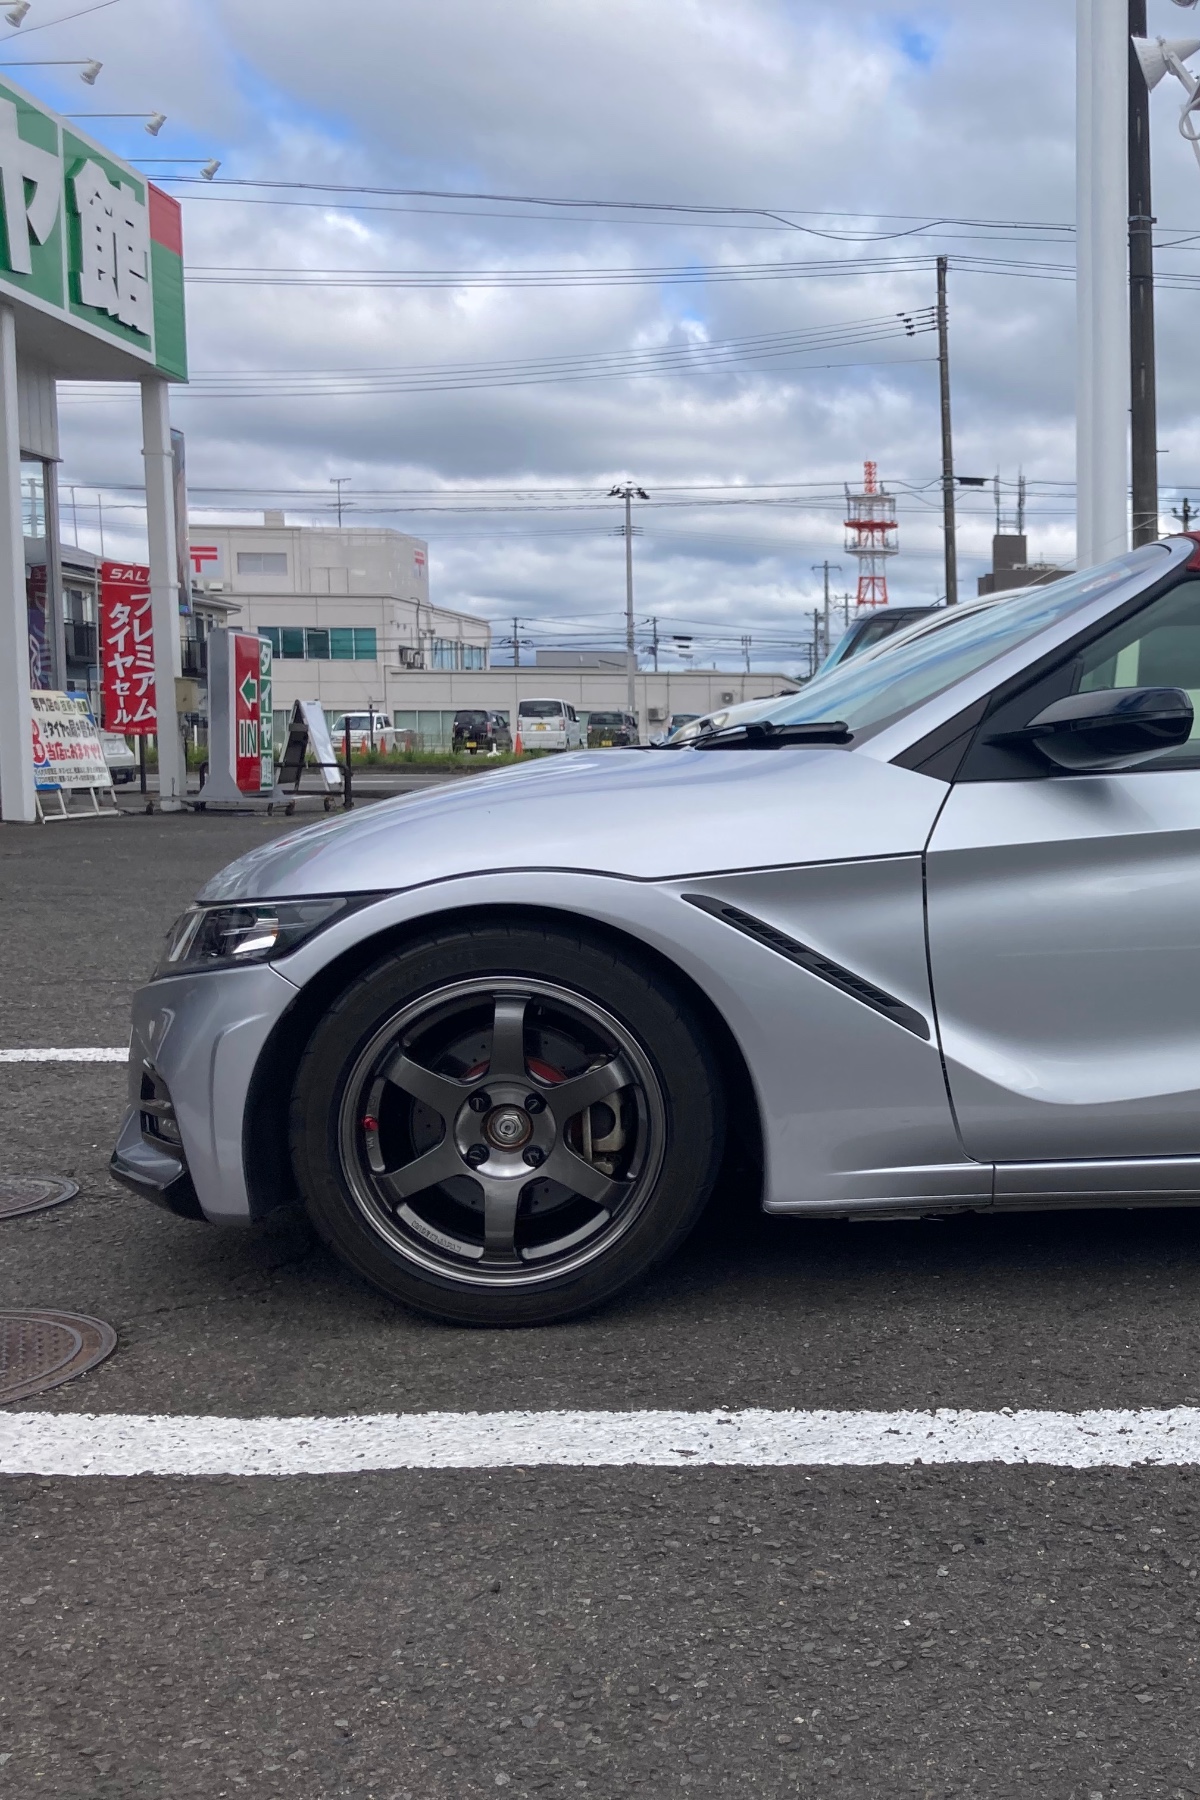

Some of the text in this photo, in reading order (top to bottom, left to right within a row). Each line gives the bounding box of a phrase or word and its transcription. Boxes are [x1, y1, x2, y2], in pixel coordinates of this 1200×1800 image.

[109, 568, 150, 582] SAL
[107, 602, 135, 725] タイヤセール
[239, 719, 258, 757] IN
